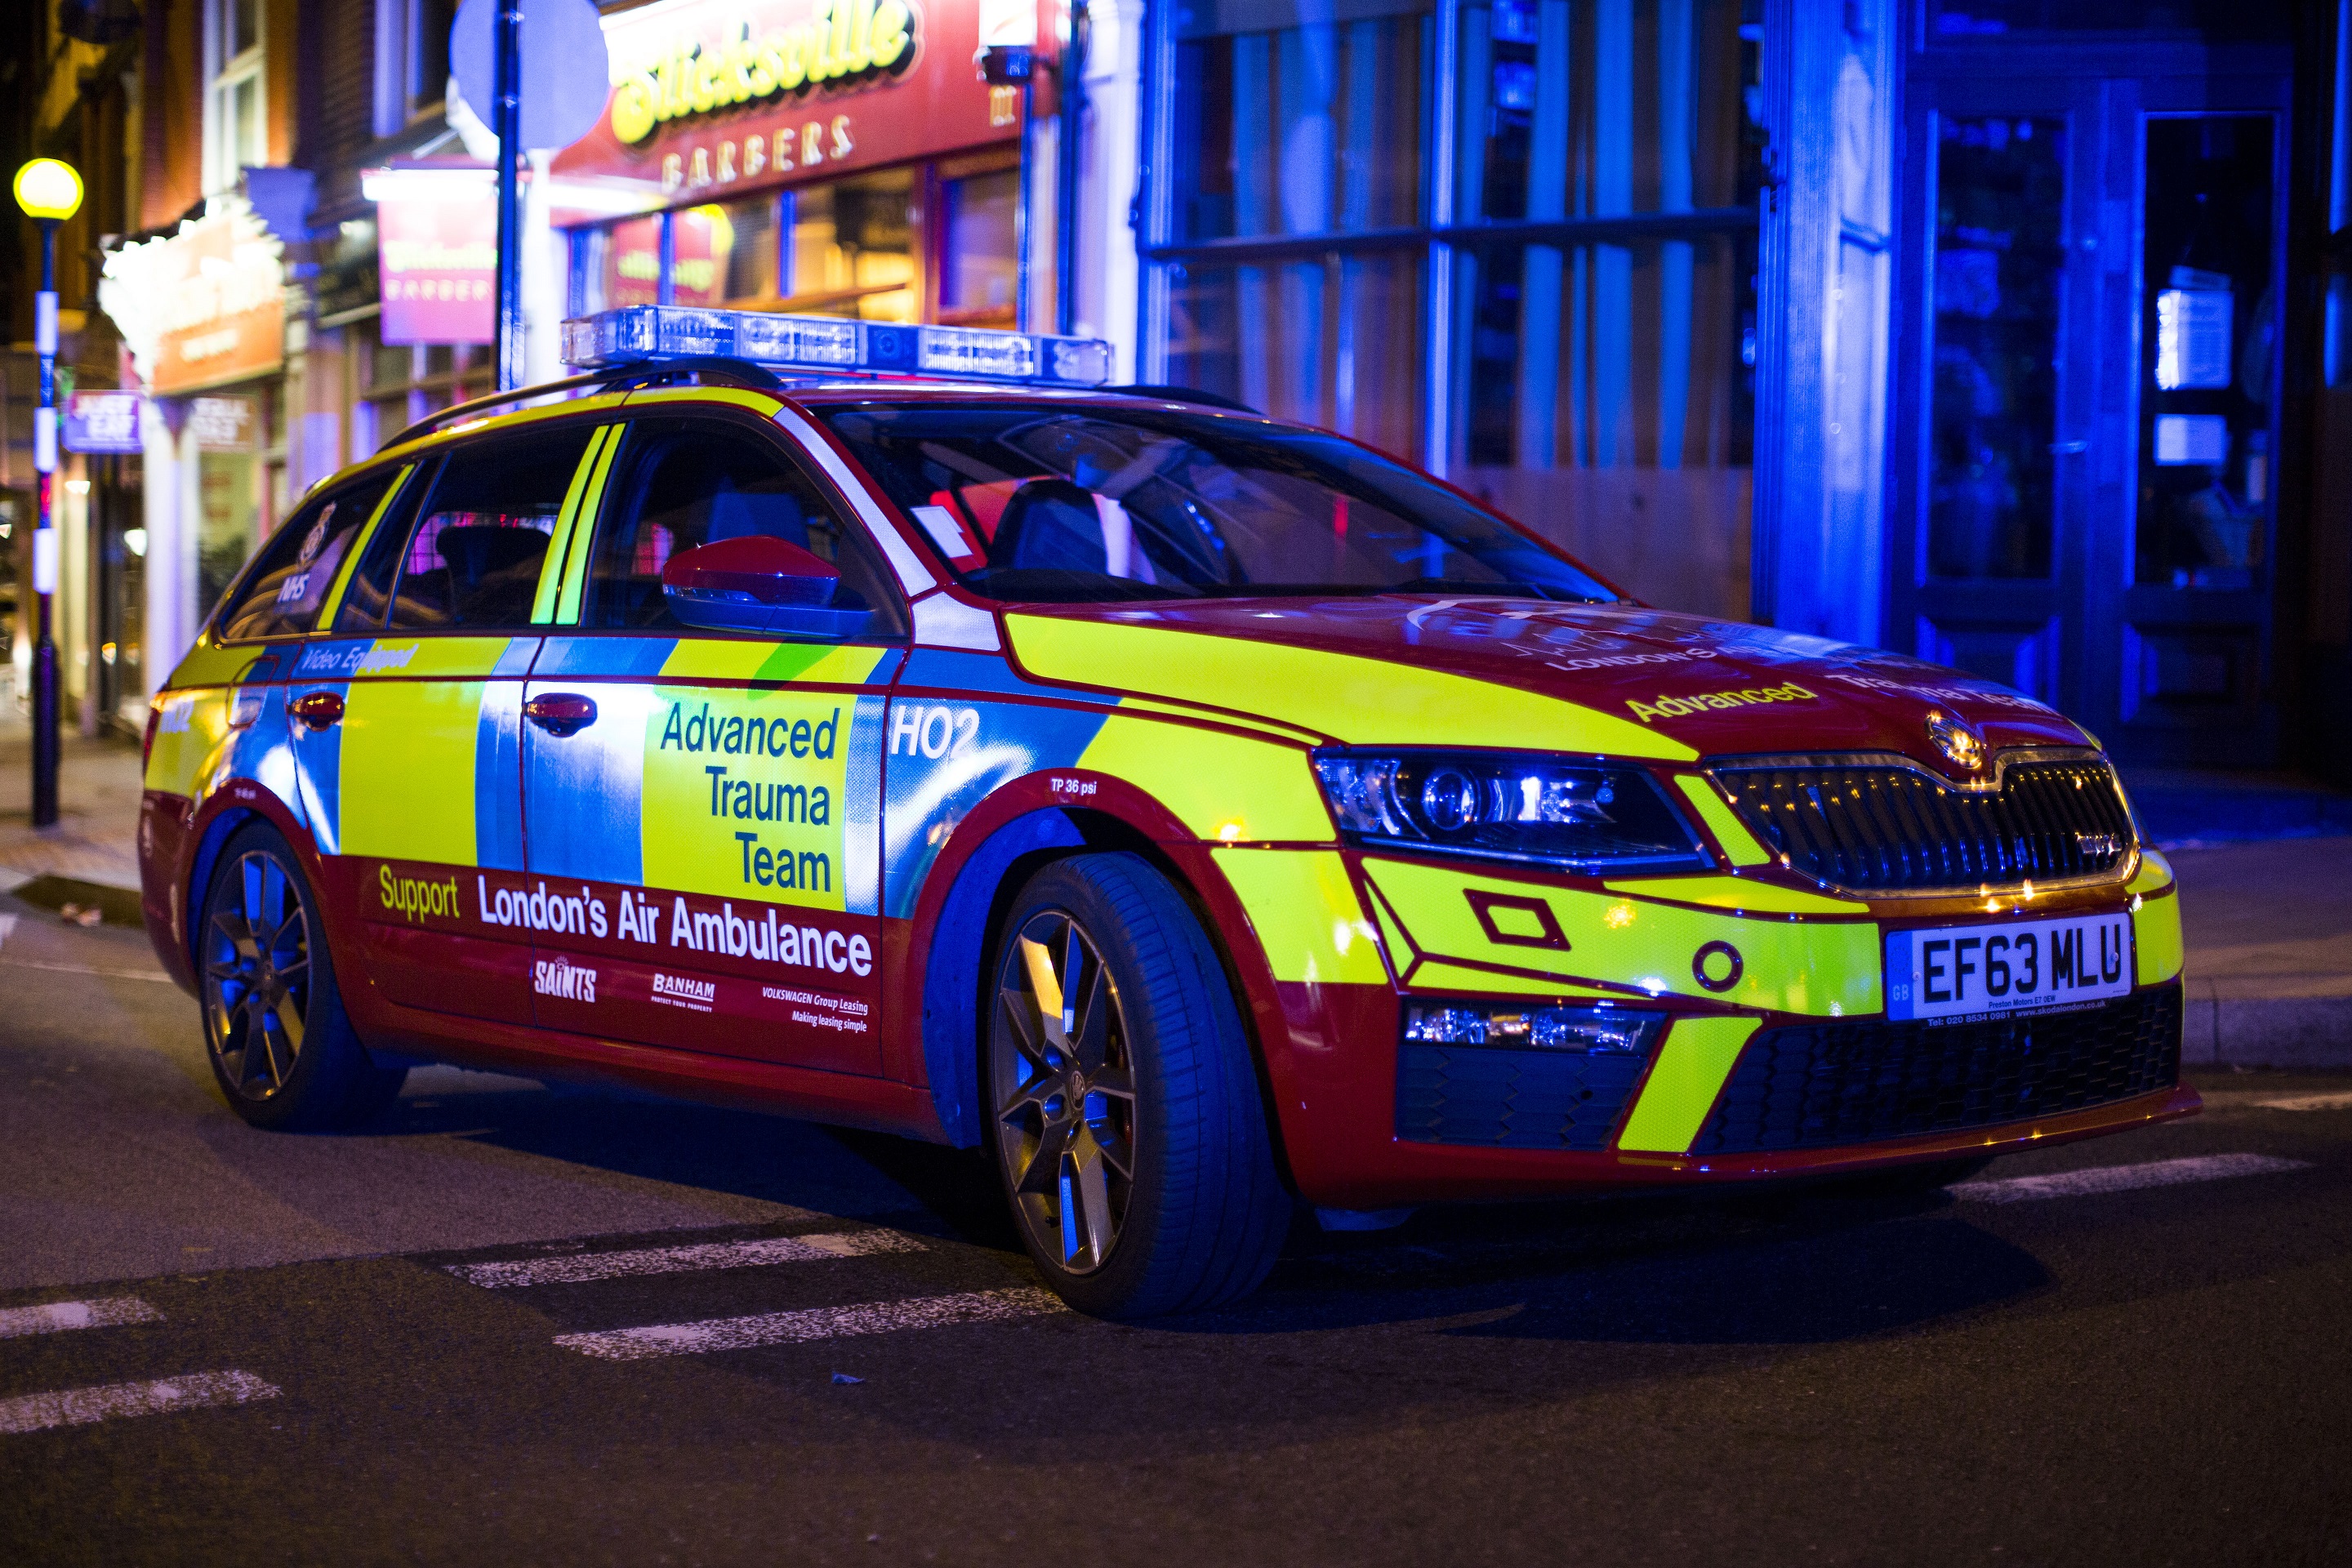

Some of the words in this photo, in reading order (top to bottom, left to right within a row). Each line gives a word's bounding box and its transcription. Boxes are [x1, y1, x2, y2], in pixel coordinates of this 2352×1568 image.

[612, 0, 911, 144] Slicksville
[661, 114, 853, 194] BARBERS
[278, 573, 310, 603] NHS
[301, 648, 342, 670] Video
[1545, 648, 1717, 671] LONDON'S
[1625, 682, 1818, 723] Advanced
[660, 702, 840, 760] Advanced
[705, 764, 831, 826] Trauma
[1051, 778, 1063, 792] TP
[1066, 780, 1080, 794] 36
[1081, 782, 1098, 795] psi
[735, 831, 831, 893] Team
[380, 863, 460, 924] Support
[478, 874, 608, 938] London's
[617, 890, 659, 944] Air
[670, 897, 873, 977] Ambulance
[1922, 932, 2039, 1004] EF63
[2051, 924, 2122, 991] MLU
[653, 973, 715, 999] BANHAM
[1893, 985, 1909, 1001] GB
[651, 996, 672, 1005] PROTECT
[673, 999, 686, 1009] YOUR
[687, 1001, 713, 1013] PROPERTY
[763, 987, 813, 1005] VOLKSWAGEN
[814, 995, 839, 1011] Group
[840, 998, 869, 1016] Leasing
[1927, 1018, 1944, 1027] Tel:
[1946, 1016, 1963, 1025] 020
[1966, 1013, 1988, 1023] 8534
[2016, 1000, 2106, 1018] www.skodalondon.co.uk
[1989, 1000, 2012, 1009] Preston
[2013, 997, 2034, 1007] Motors
[792, 1010, 817, 1027] Making
[818, 1013, 844, 1032] leasing
[844, 1019, 867, 1034] simple
